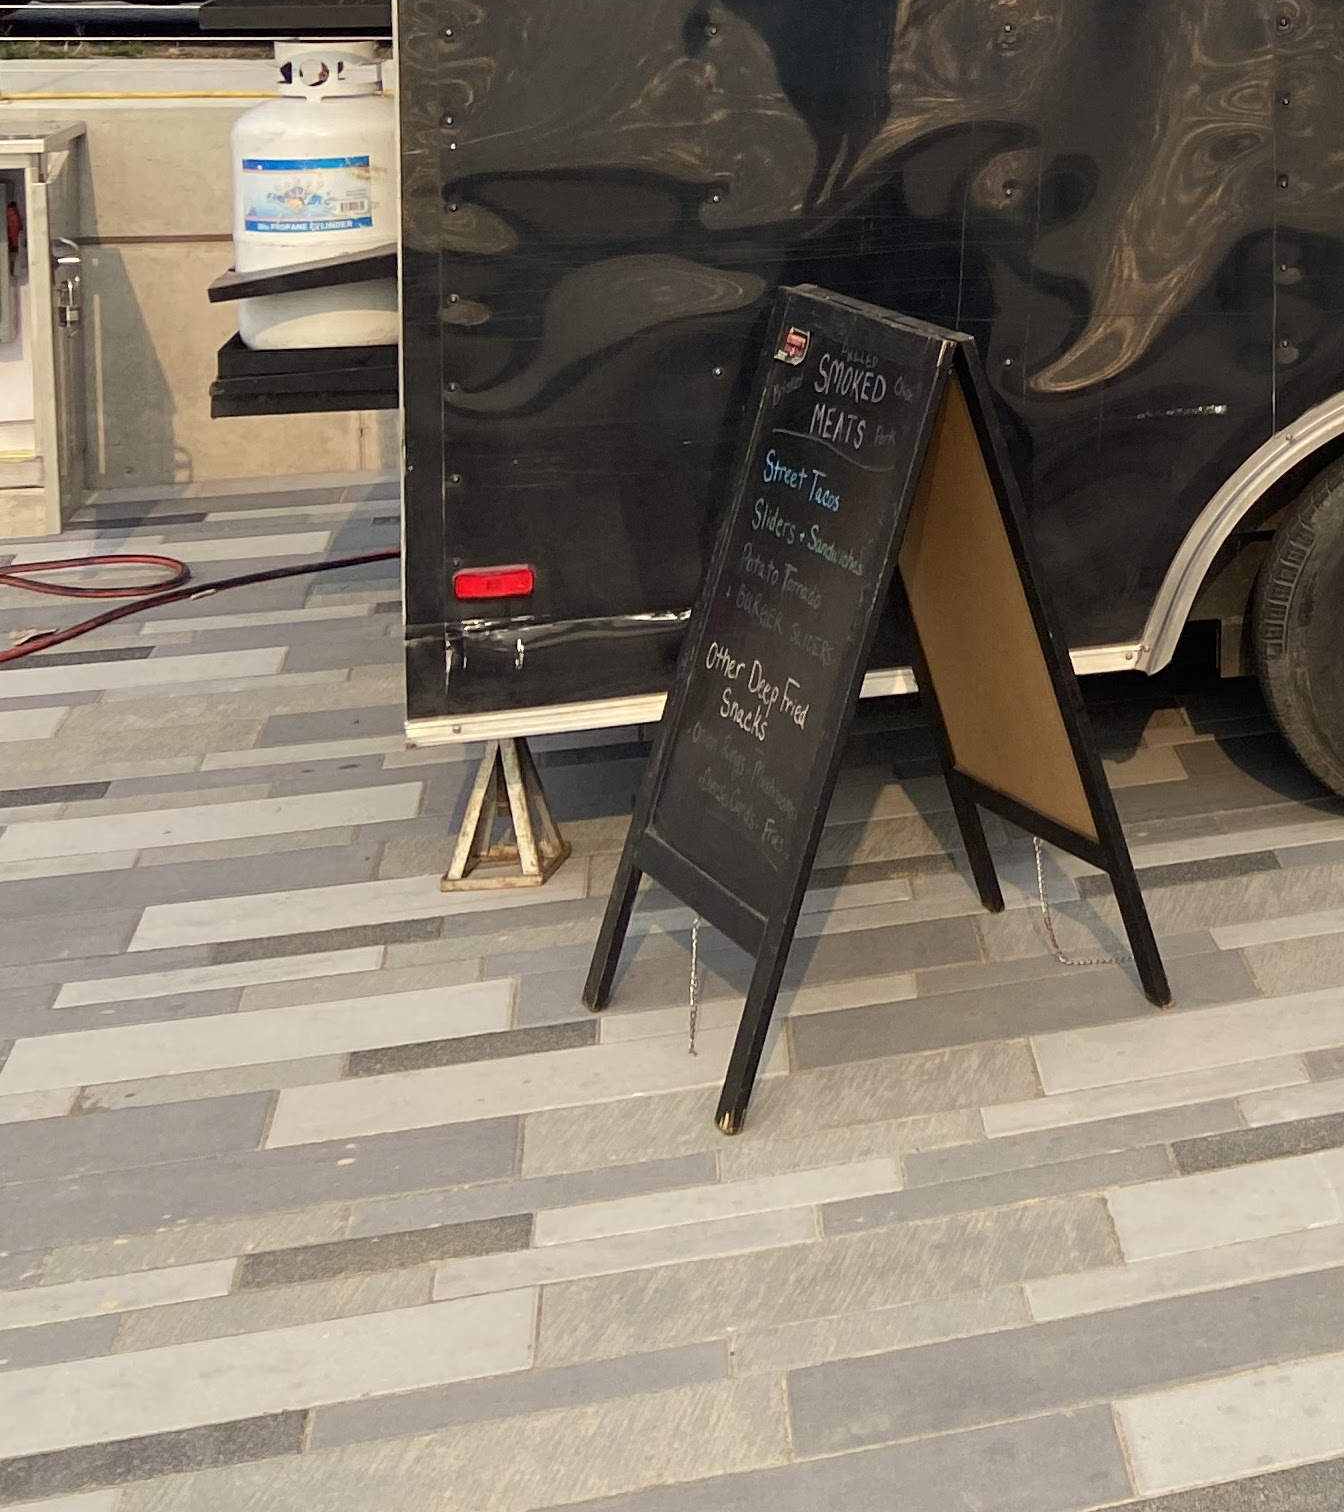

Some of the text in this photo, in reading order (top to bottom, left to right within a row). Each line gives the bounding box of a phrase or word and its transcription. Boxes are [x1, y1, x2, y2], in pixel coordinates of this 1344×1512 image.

[814, 353, 887, 404] SMOKED
[809, 402, 867, 450] MEATS
[763, 449, 841, 512] Street Tacos
[751, 497, 796, 545] Sliders
[741, 541, 822, 610] Potato Tornado
[706, 641, 810, 731] Other Deep Fried
[720, 687, 769, 741] Snacks
